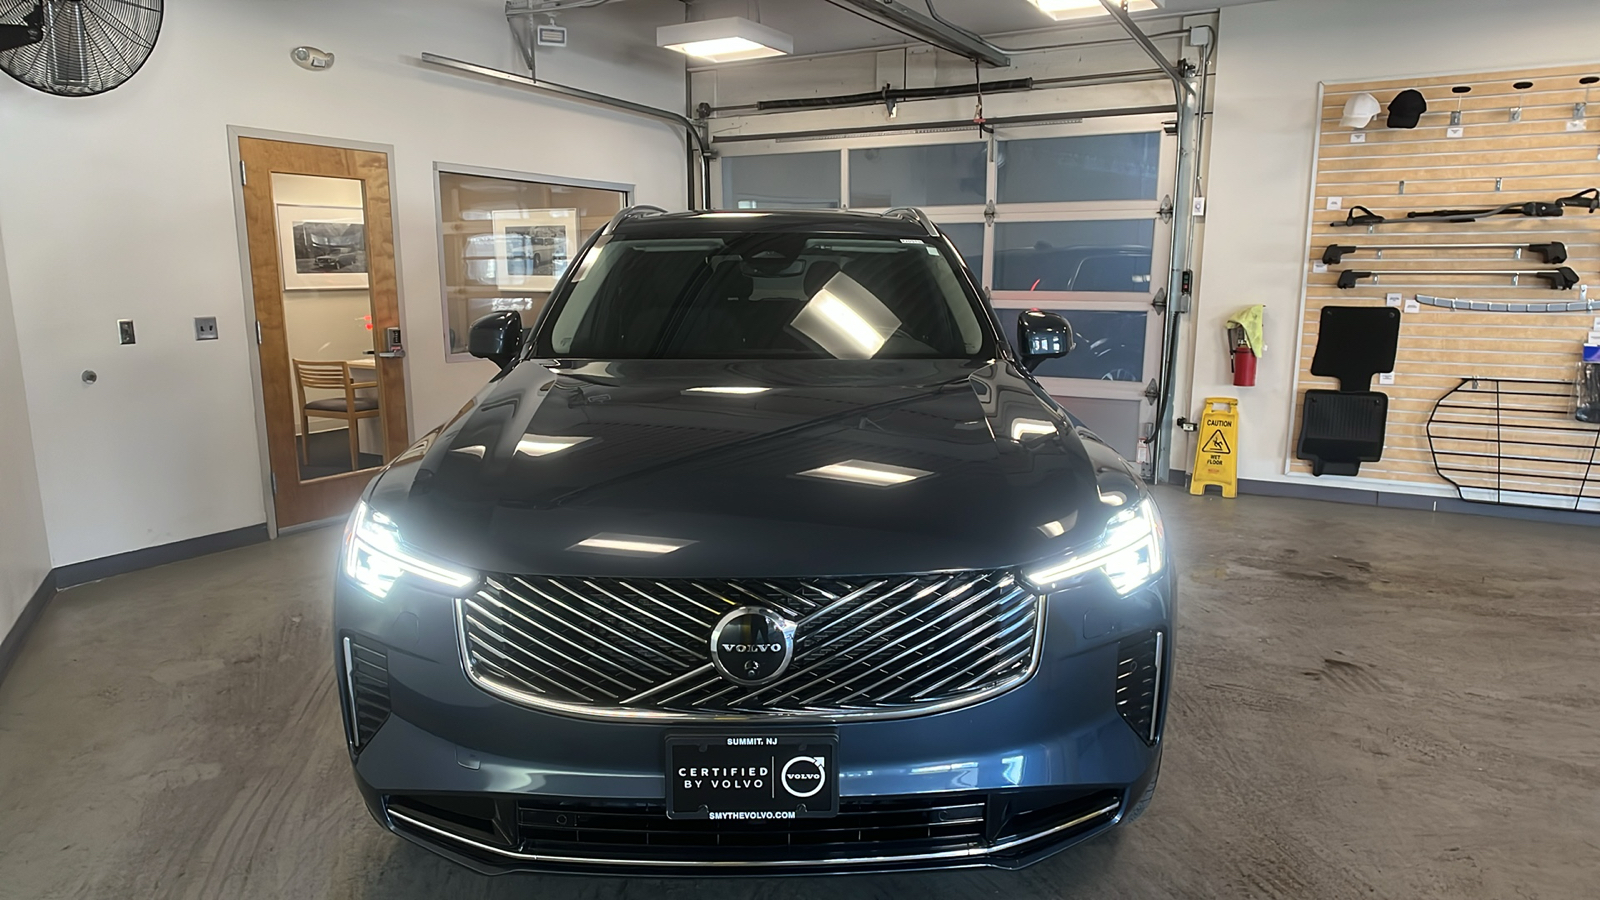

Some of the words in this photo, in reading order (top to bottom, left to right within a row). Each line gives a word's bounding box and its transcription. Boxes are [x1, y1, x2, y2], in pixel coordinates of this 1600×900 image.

[1207, 419, 1232, 427] CAUTION
[722, 643, 782, 653] VOLVO
[766, 737, 778, 746] NJ
[678, 767, 769, 777] CERTIFIED
[684, 779, 702, 789] BY
[711, 779, 764, 789] VOLVO
[708, 811, 796, 820] SMYTHEVOLVO.COM
